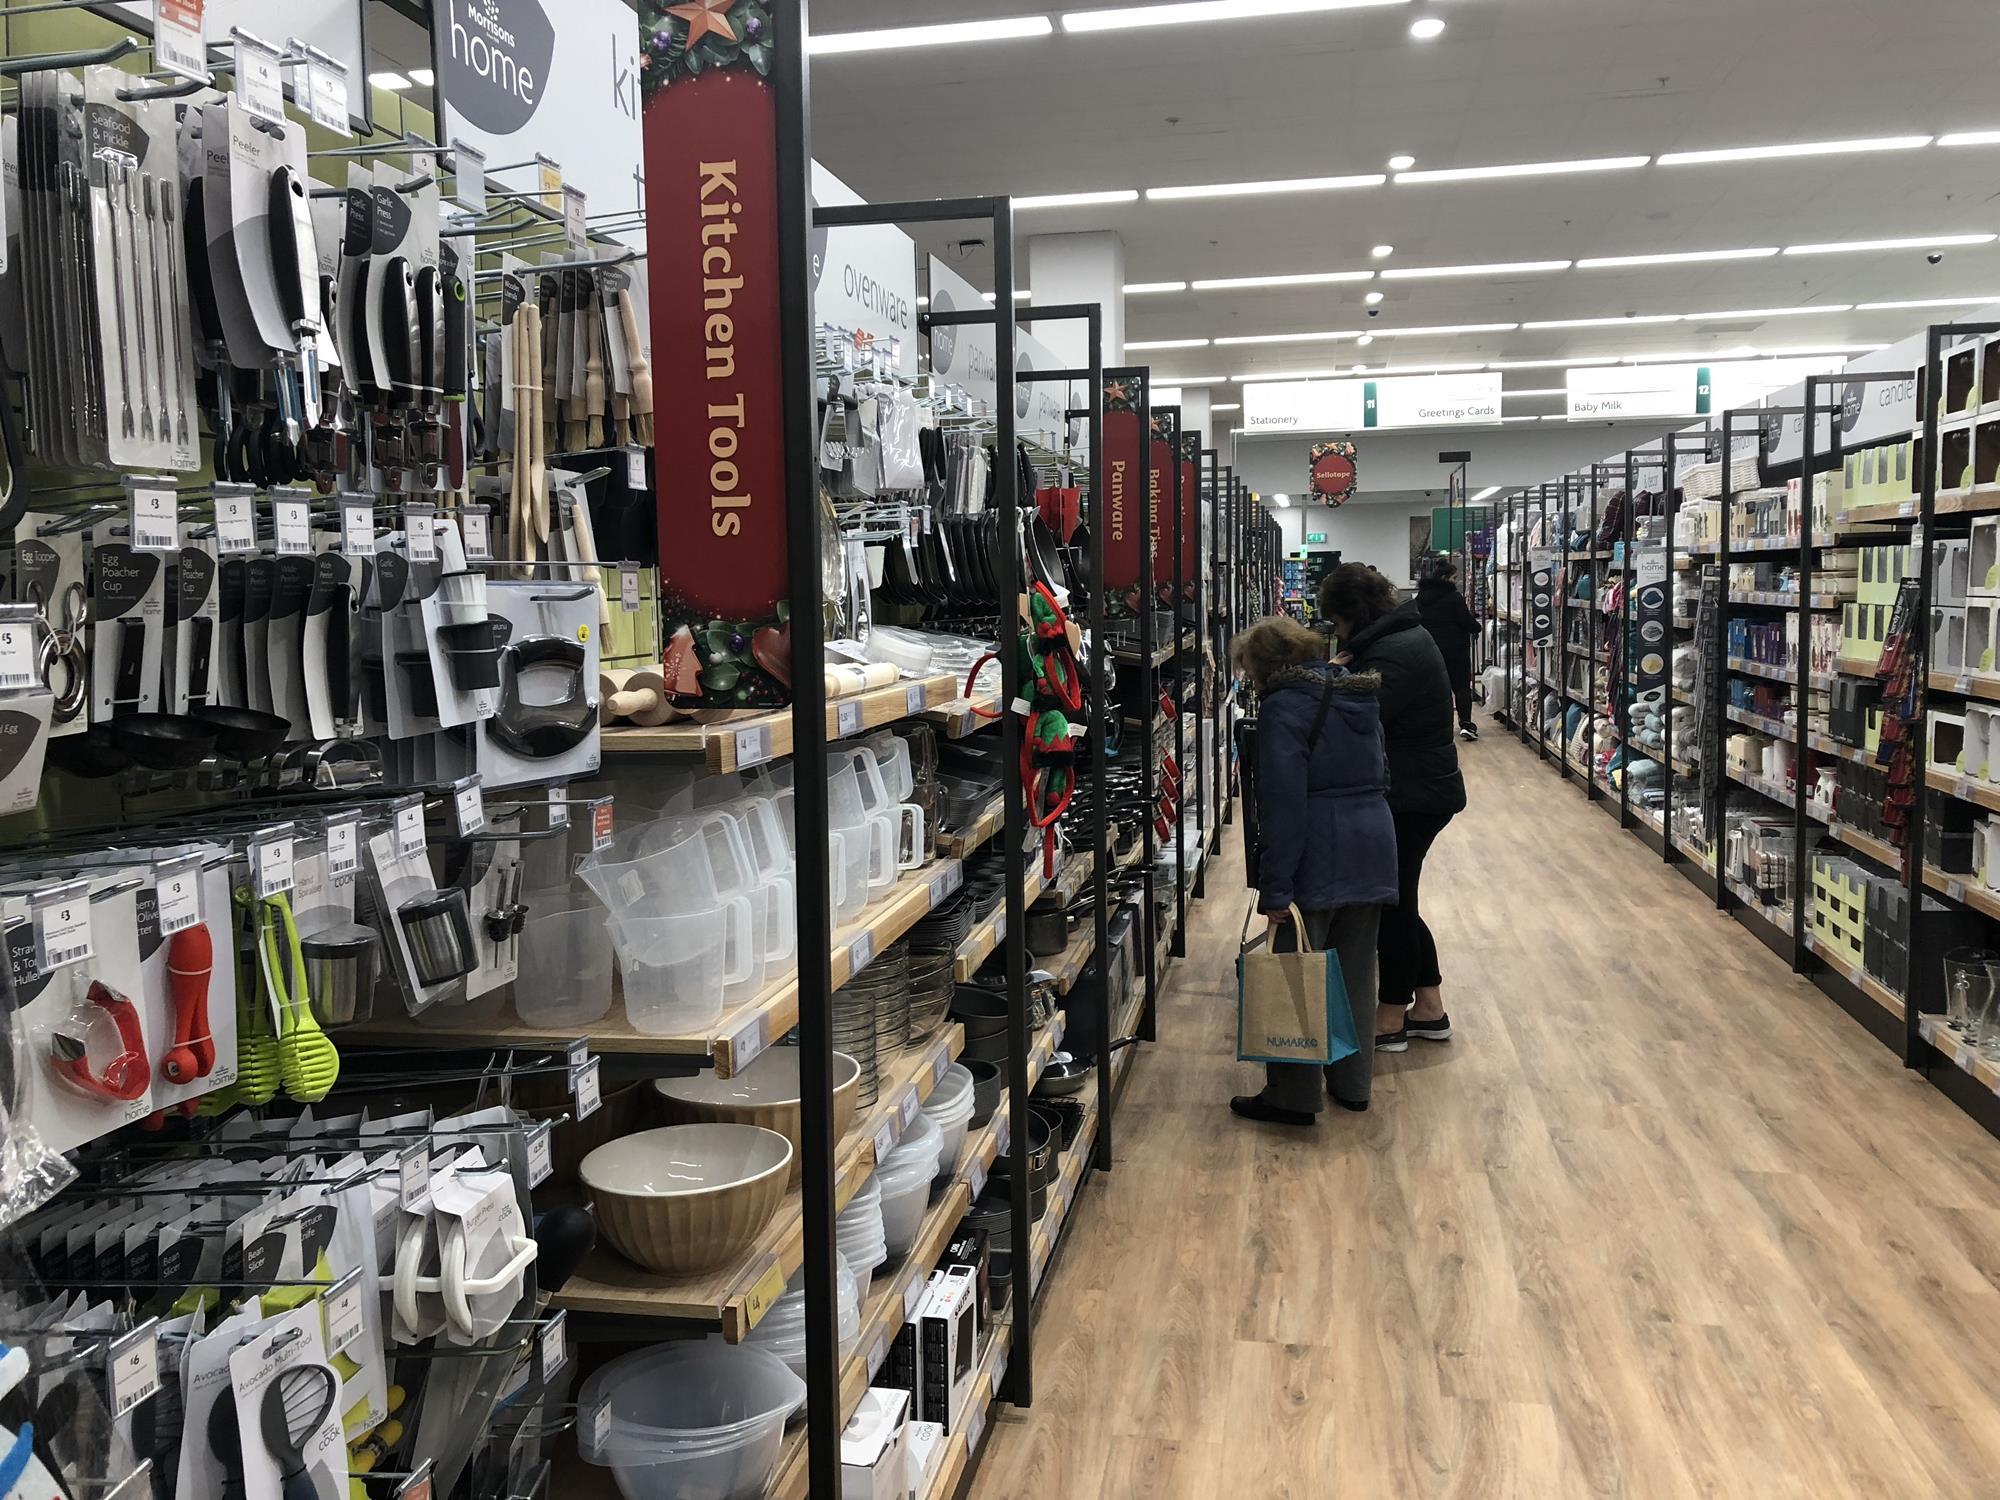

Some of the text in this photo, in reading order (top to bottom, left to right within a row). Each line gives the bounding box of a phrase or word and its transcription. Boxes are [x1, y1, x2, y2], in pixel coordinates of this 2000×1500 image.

[468, 4, 516, 48] Morrisons
[450, 0, 534, 105] home
[612, 33, 642, 121] ki
[92, 112, 131, 135] Seafood
[92, 128, 101, 139] &
[103, 132, 129, 148] Pickle
[233, 135, 261, 158] Peeler
[376, 193, 393, 209] Garlic
[376, 207, 392, 220] Press
[844, 263, 908, 330] ovenware
[698, 159, 752, 537] Kitchen Tools
[1698, 384, 1710, 395] 12
[1880, 379, 1915, 408] candle
[1366, 399, 1375, 409] 11
[1574, 400, 1622, 413] Baby Milk
[1843, 400, 1861, 419] home
[1418, 405, 1495, 419] Greetings Cards
[1250, 415, 1299, 428] Stationery
[169, 455, 198, 469] home
[1316, 471, 1351, 480] Sellotape
[151, 498, 159, 509] £3
[1111, 460, 1126, 541] Panware
[22, 550, 34, 565] Egg
[102, 553, 119, 567] Egg
[182, 556, 193, 569] Egg
[102, 566, 140, 577] Poacher
[182, 569, 205, 579] Poacher
[1641, 563, 1665, 571] home
[102, 580, 122, 593] Cup
[183, 582, 195, 593] Cup
[173, 883, 181, 893] £3
[61, 909, 71, 921] £3
[137, 911, 160, 923] Olive
[13, 961, 21, 973] &
[208, 1071, 236, 1087] home
[125, 1103, 151, 1121] home
[300, 1212, 323, 1229] ettuce
[466, 1201, 495, 1230] Burger Press
[163, 1251, 181, 1267] Bean
[248, 1246, 265, 1261] Bean
[163, 1263, 181, 1279] Slicer
[248, 1257, 266, 1272] Slicer
[130, 1354, 140, 1365] £6
[238, 1333, 313, 1392] Avocado Multi-Tool
[193, 1364, 231, 1384] Avocad
[363, 1412, 385, 1431] home
